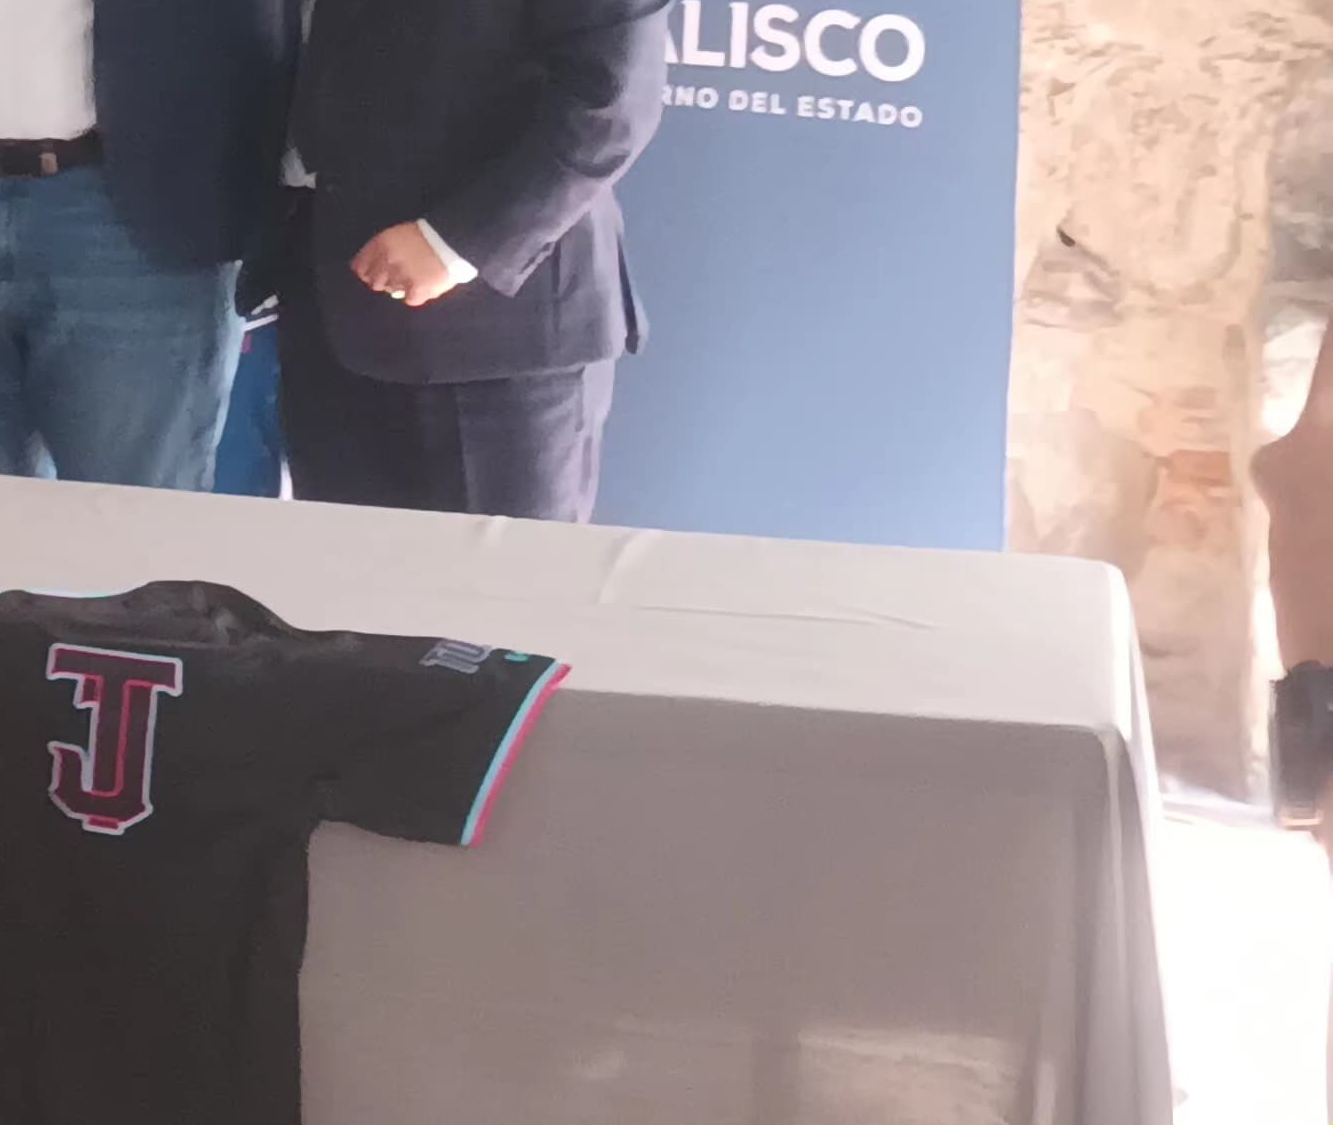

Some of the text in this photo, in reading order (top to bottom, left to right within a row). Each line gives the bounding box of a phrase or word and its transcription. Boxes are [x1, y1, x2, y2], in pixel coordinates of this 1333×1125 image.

[664, 0, 925, 81] LISCO
[729, 90, 786, 115] DEL
[797, 96, 923, 128] ESTADO
